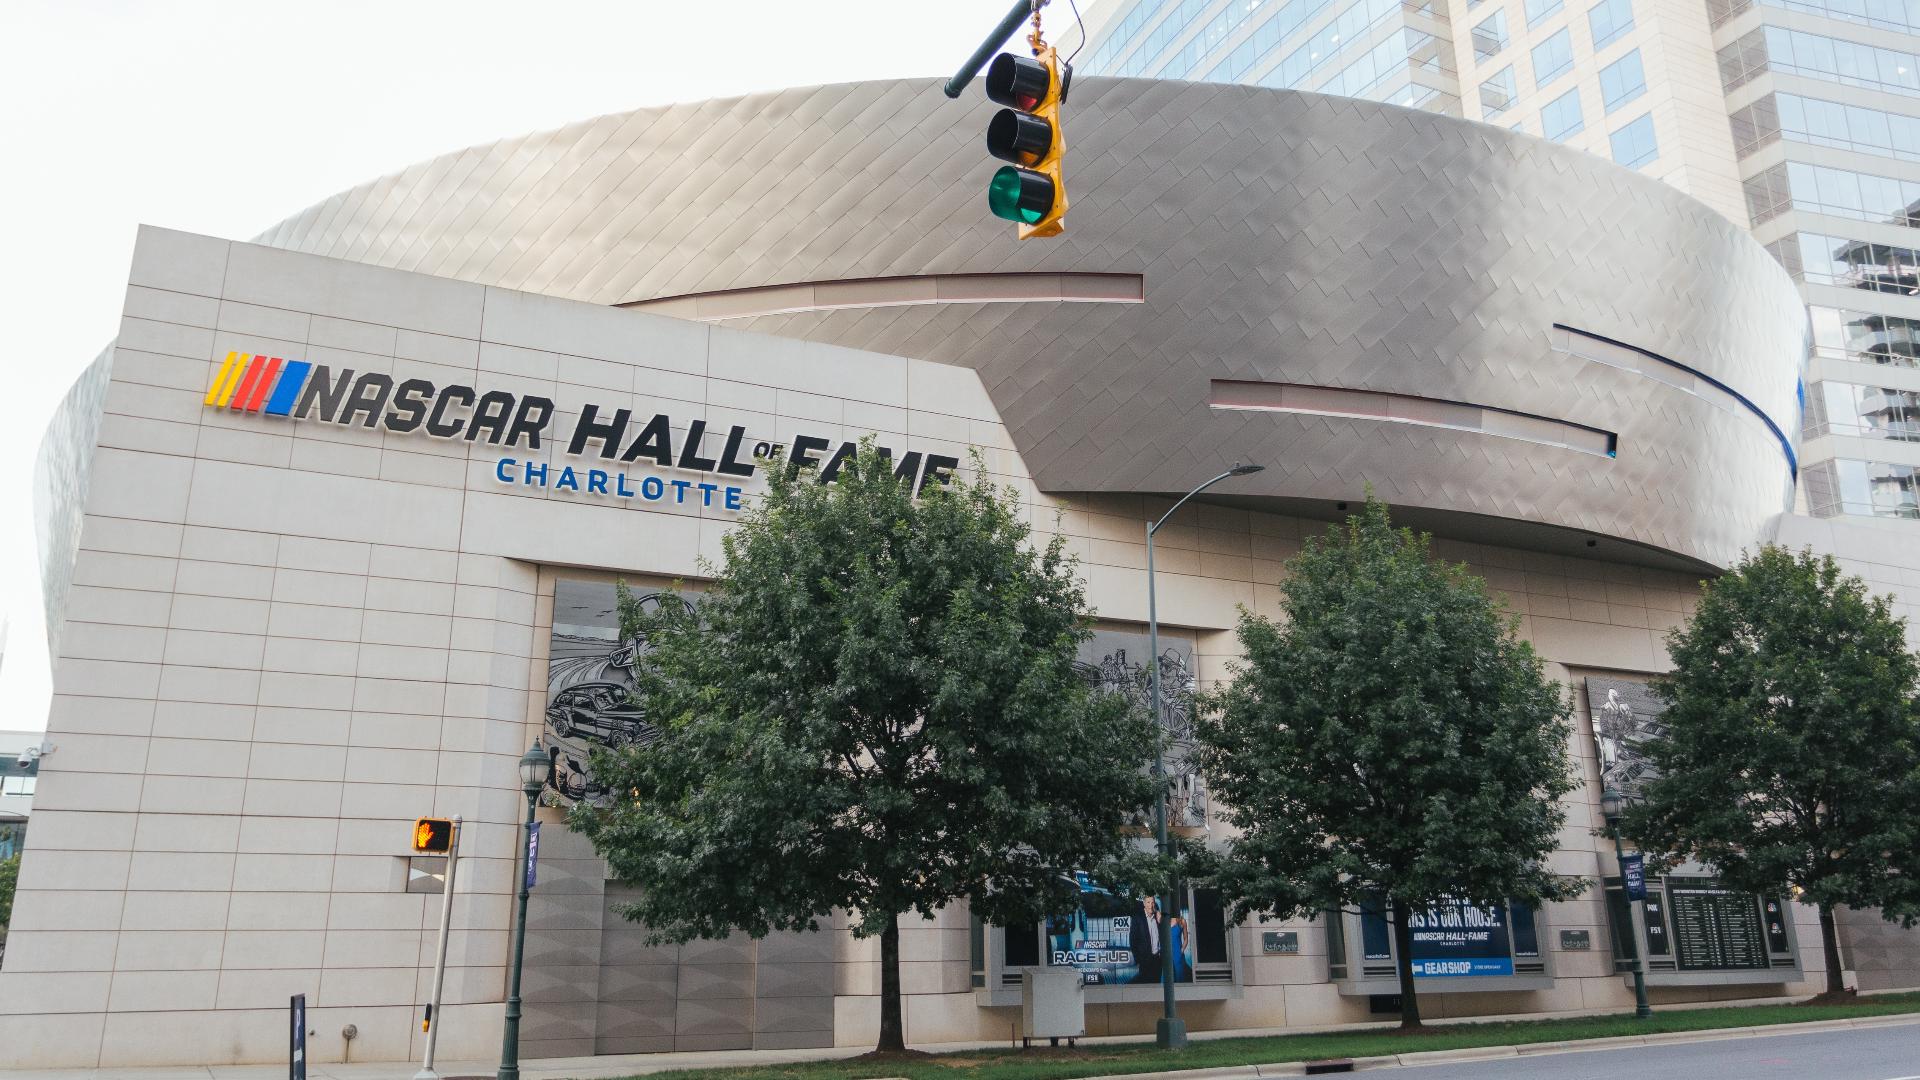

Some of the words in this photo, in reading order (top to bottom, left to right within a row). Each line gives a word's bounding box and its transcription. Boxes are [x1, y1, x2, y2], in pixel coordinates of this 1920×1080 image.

[293, 364, 555, 449] NASCAR
[566, 403, 756, 477] HALL
[496, 457, 742, 511] CHARLOTTE
[1113, 918, 1129, 927] FOX
[1446, 932, 1465, 940] HALL
[1468, 932, 1488, 940] FAME
[1054, 951, 1096, 964] RACE
[1097, 951, 1130, 964] HUB
